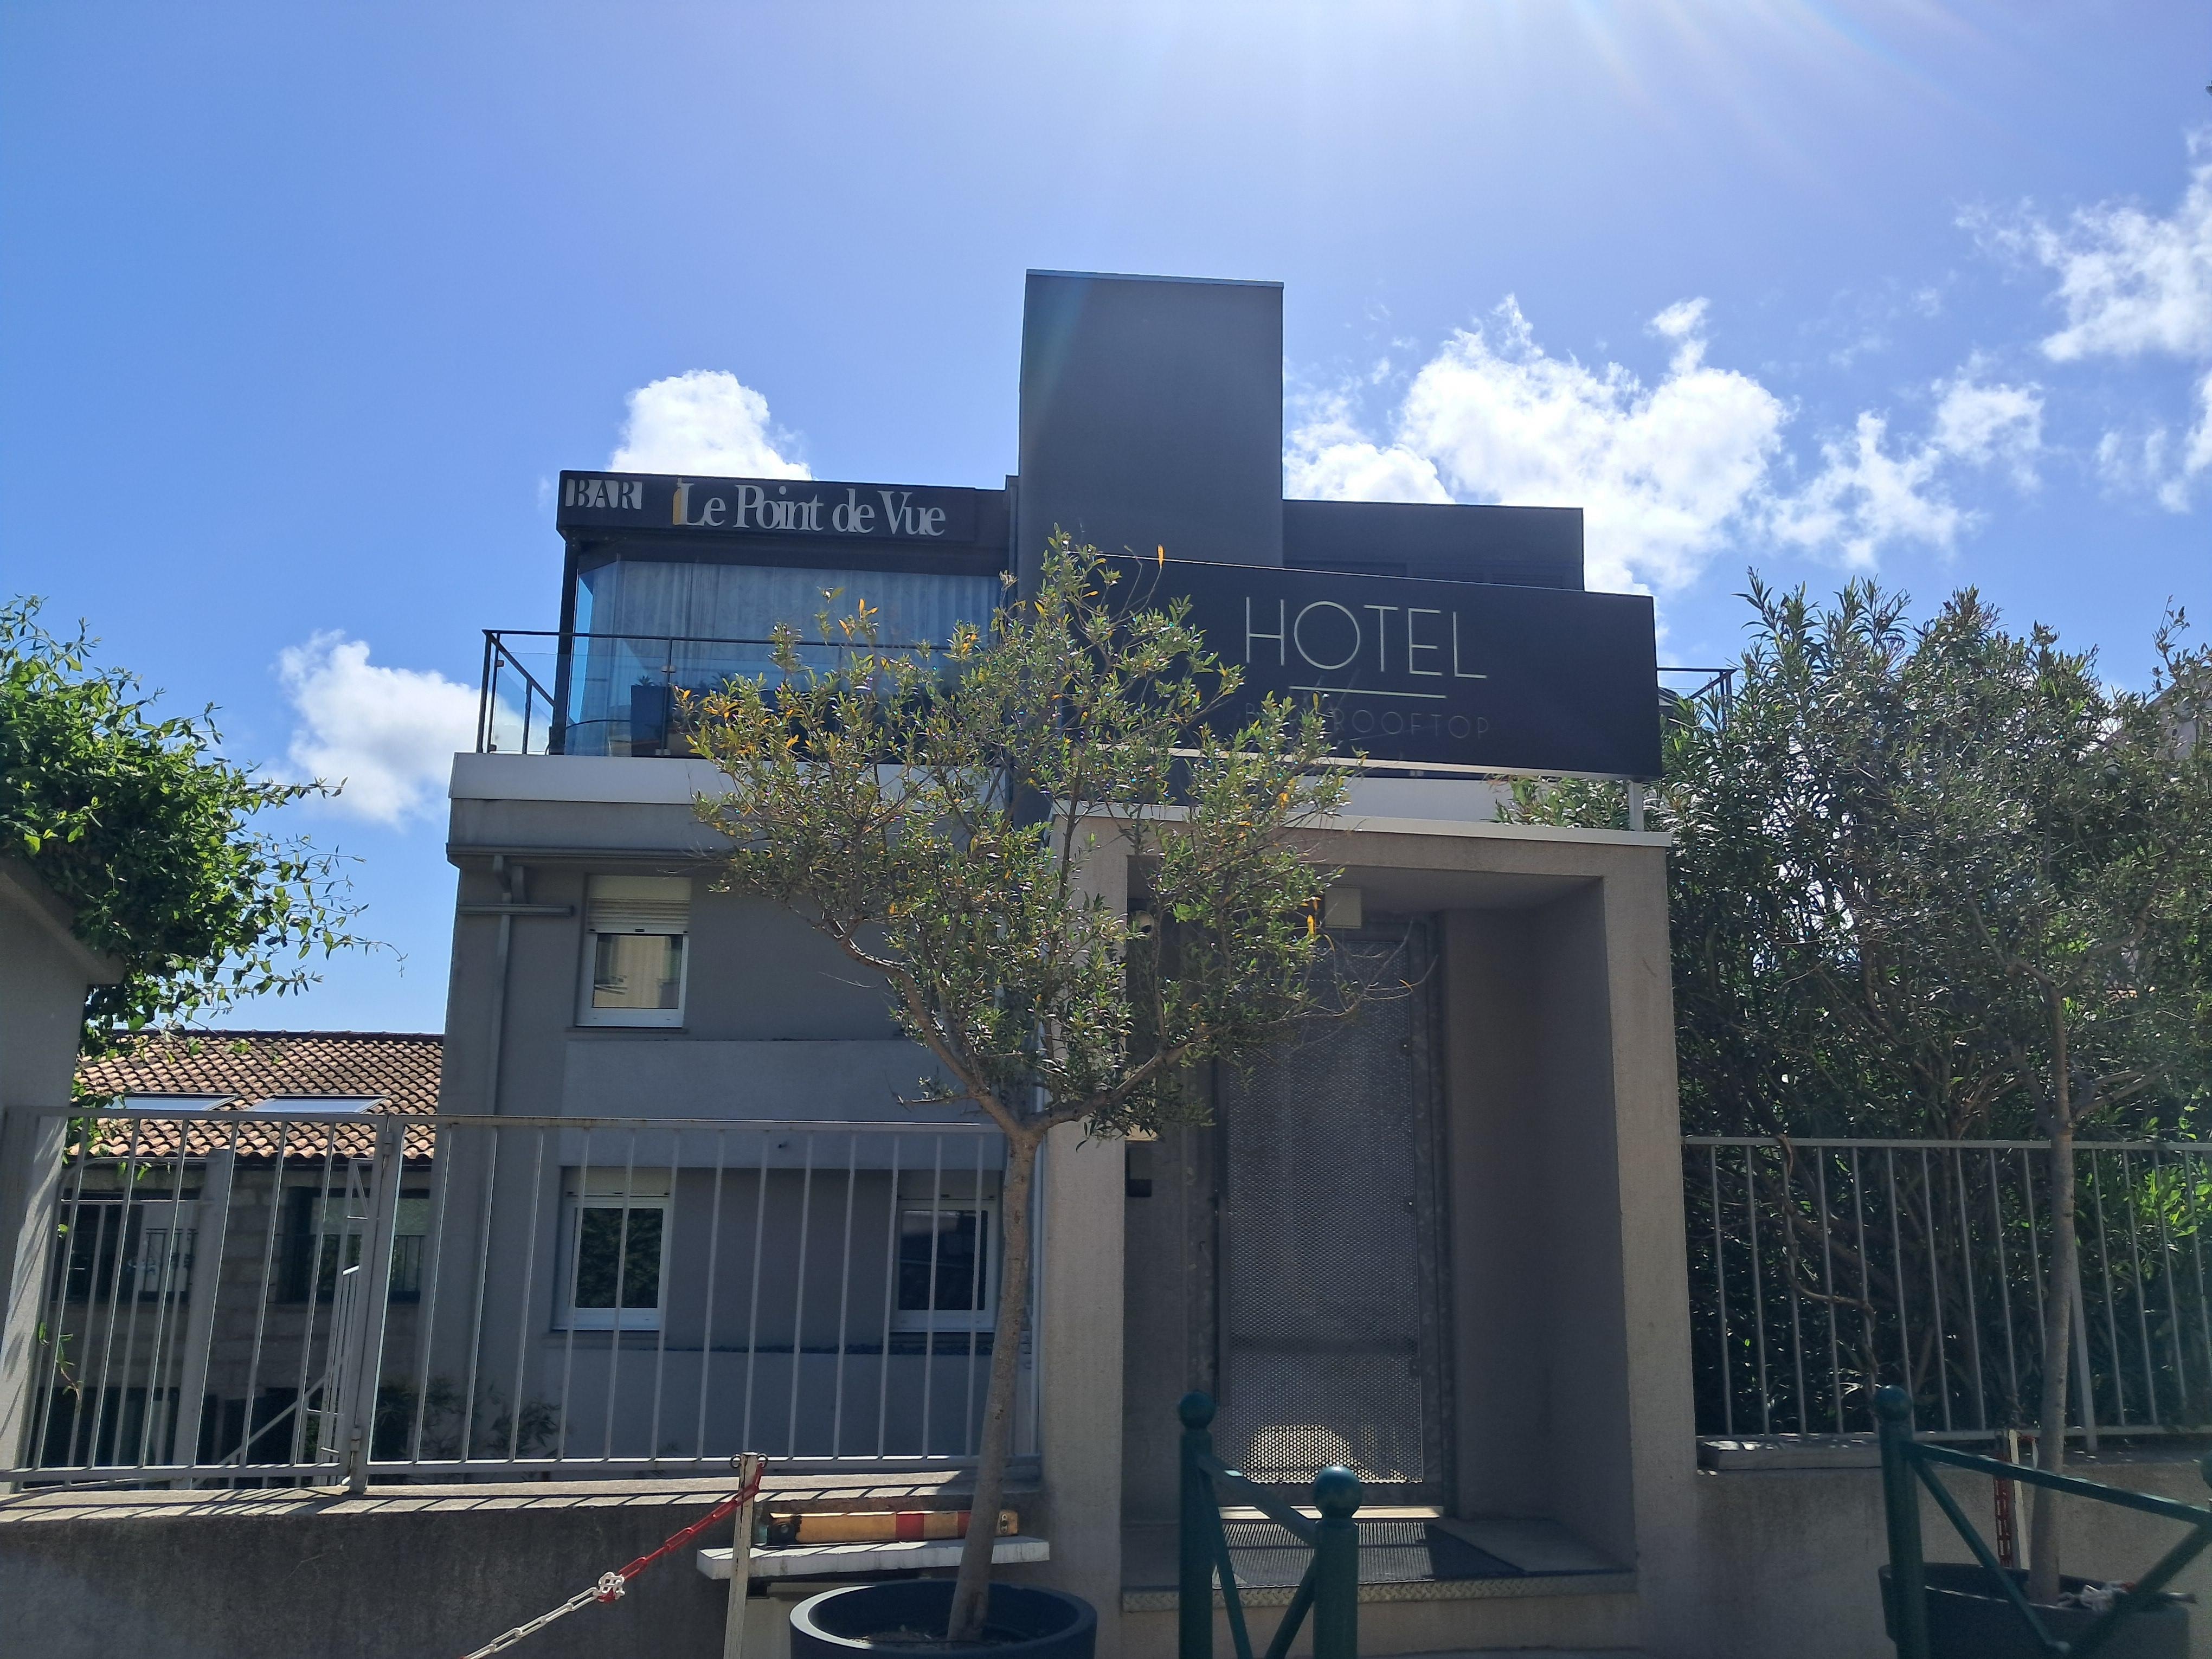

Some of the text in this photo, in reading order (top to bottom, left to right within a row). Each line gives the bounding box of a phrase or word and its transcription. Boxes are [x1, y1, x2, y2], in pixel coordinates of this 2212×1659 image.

[564, 478, 946, 537] BAR Le Point de Vue
[1245, 595, 1488, 679] HOTEL
[1333, 707, 1489, 740] ROOFTOP
